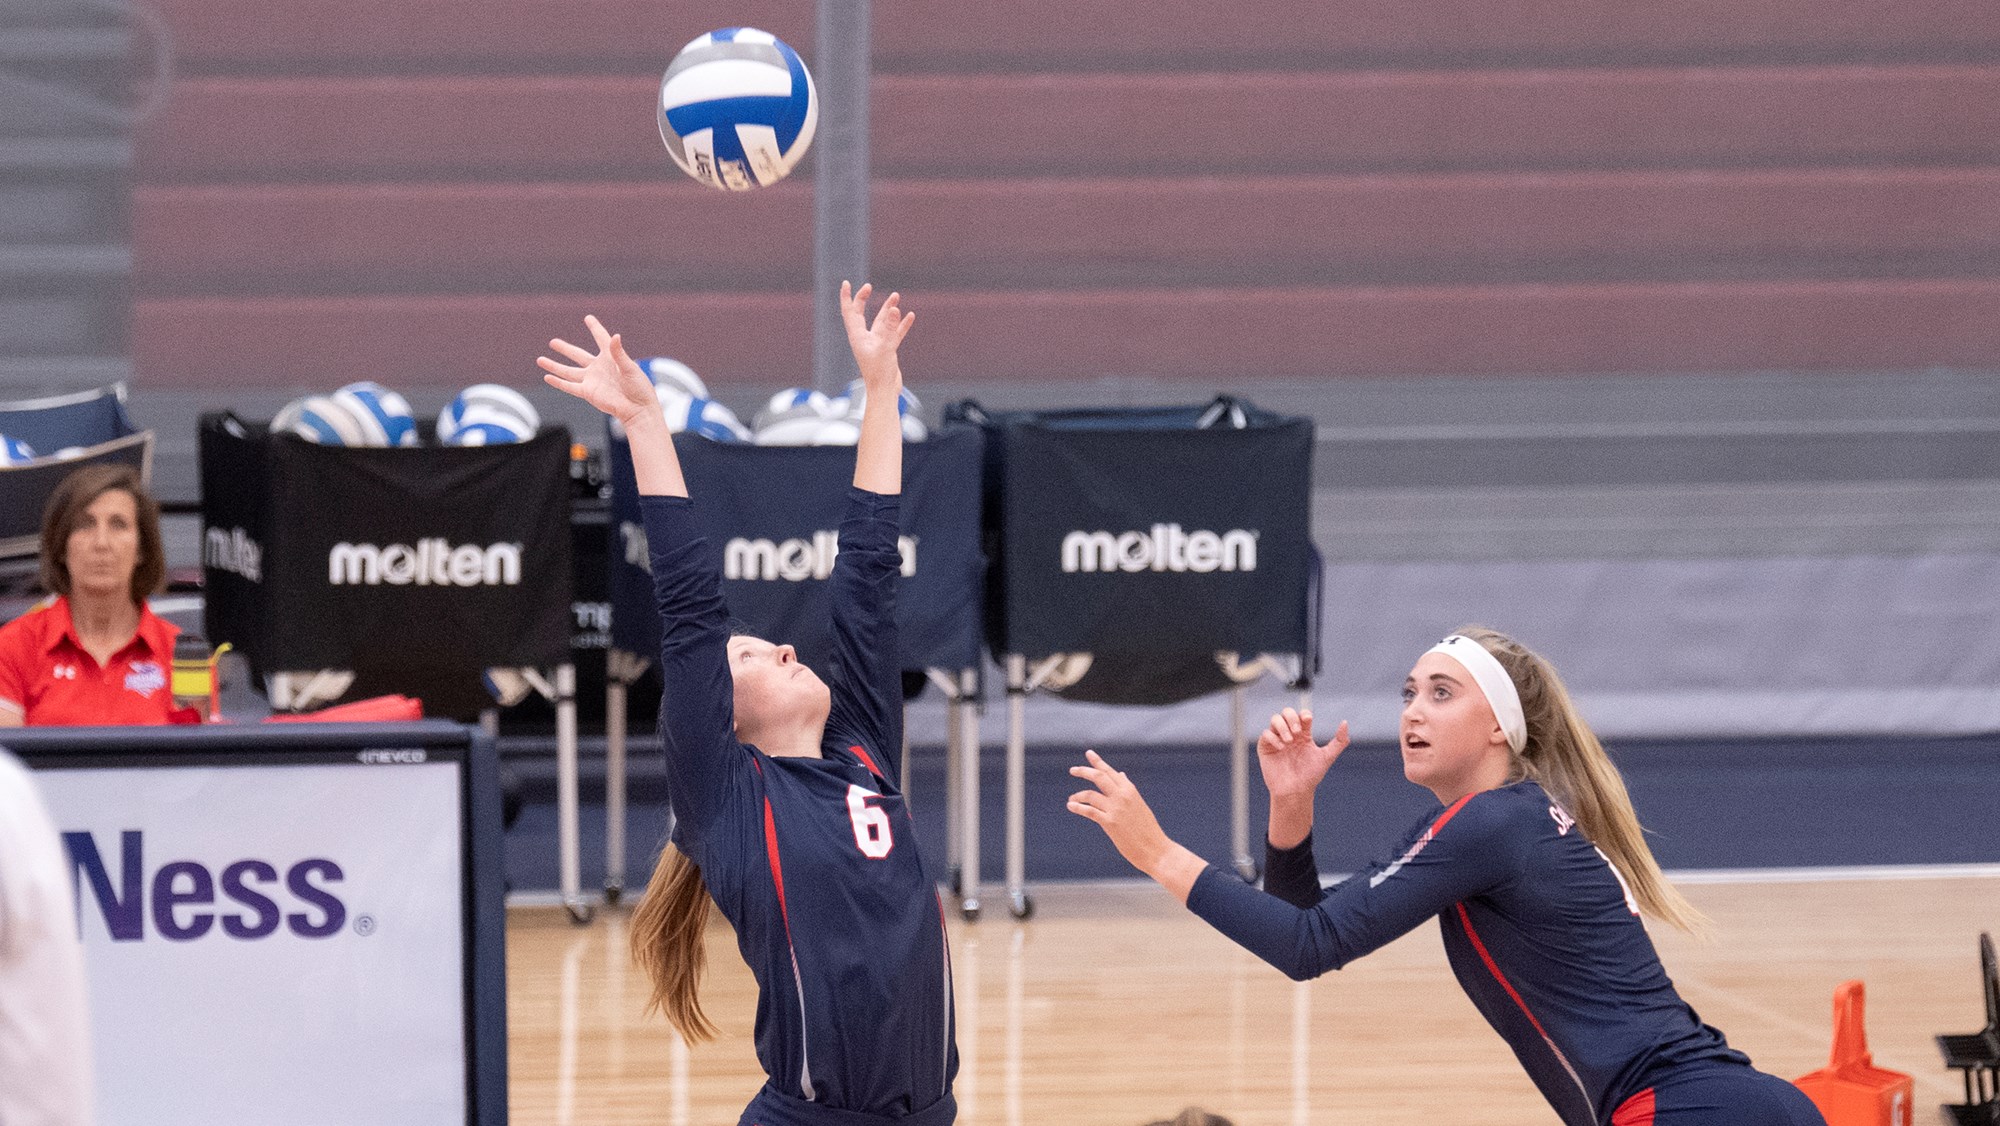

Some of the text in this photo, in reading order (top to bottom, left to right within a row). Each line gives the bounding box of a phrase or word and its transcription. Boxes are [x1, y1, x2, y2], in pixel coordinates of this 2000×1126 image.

[328, 537, 521, 587] molten
[723, 530, 917, 581] moln
[1061, 523, 1257, 573] molten
[846, 783, 894, 860] 6
[60, 830, 346, 943] Ness
